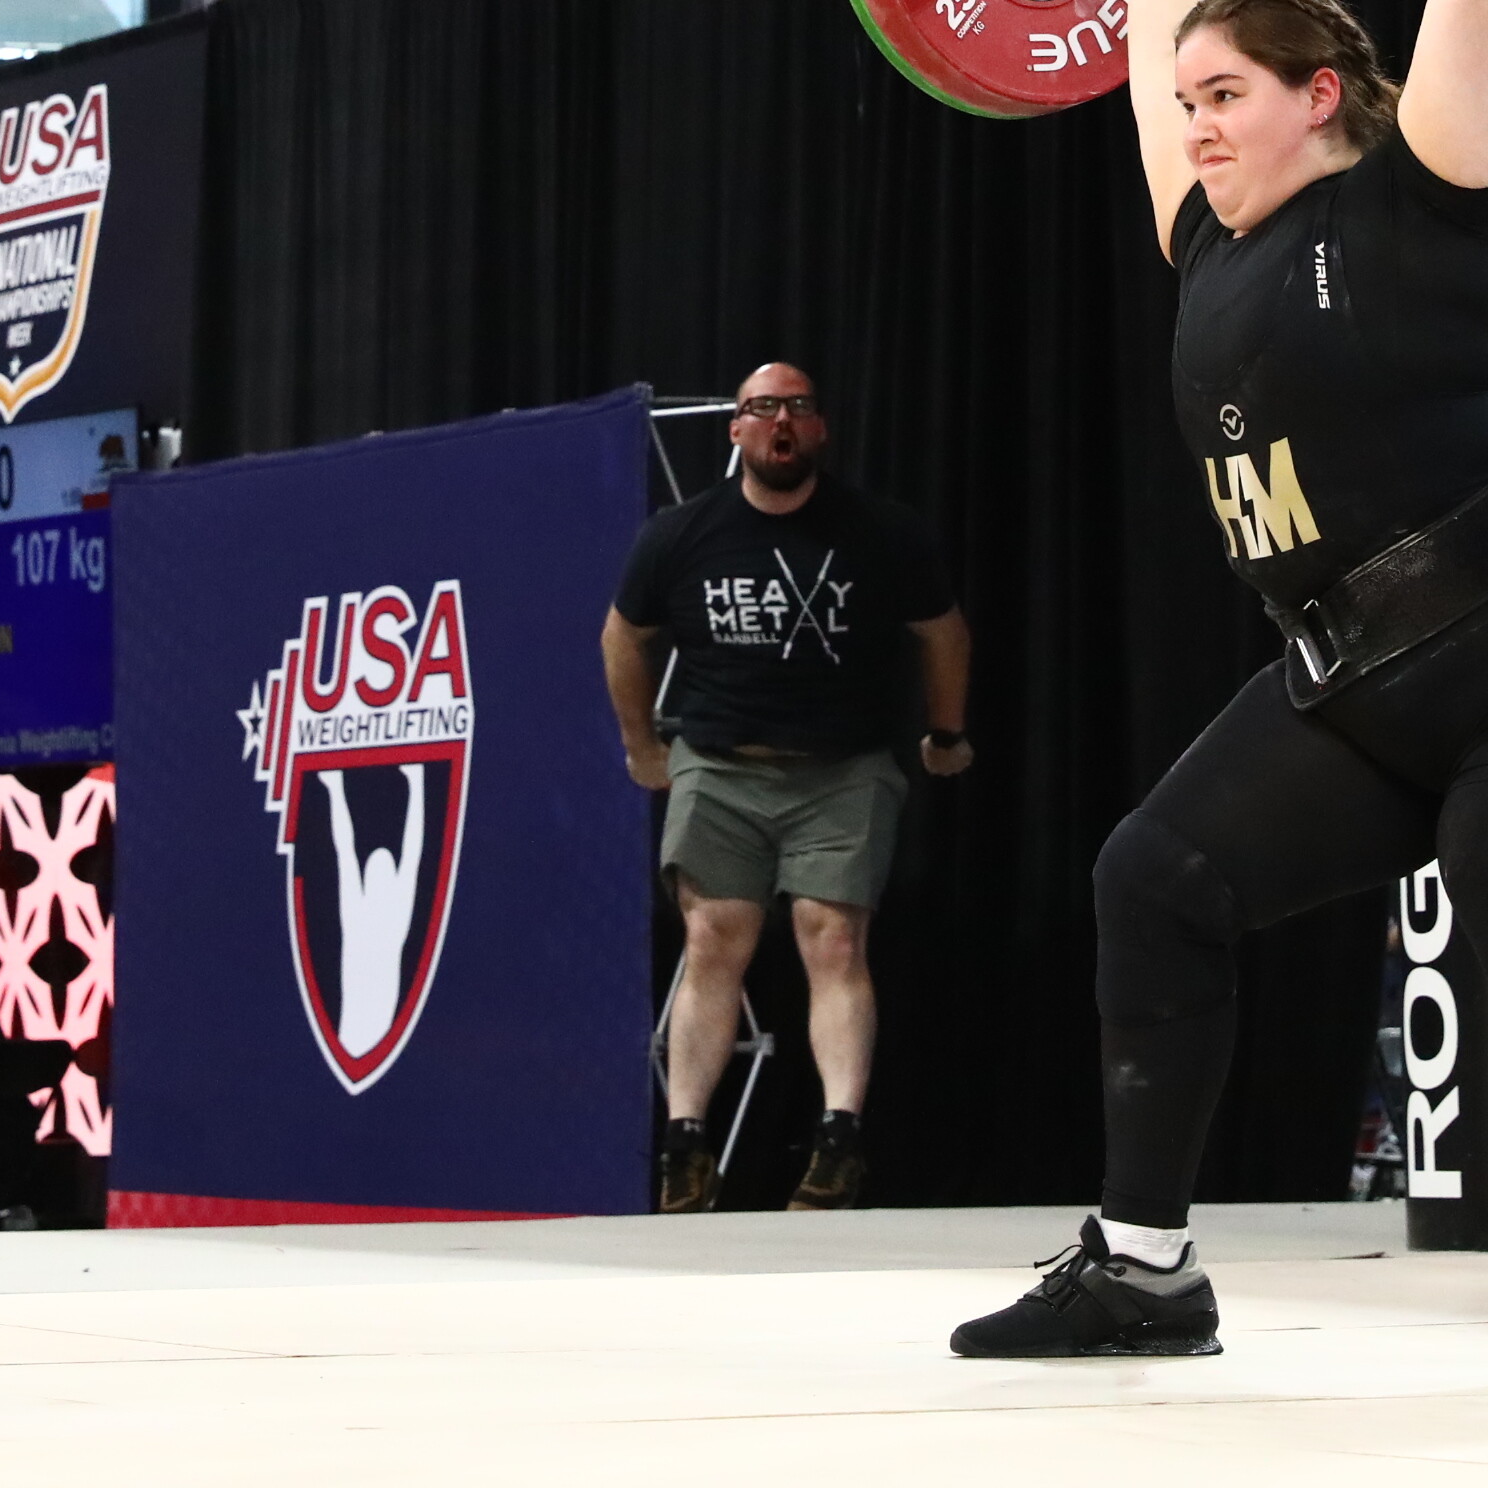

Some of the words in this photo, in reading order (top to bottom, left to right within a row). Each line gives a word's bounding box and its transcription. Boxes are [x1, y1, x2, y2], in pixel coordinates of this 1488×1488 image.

[956, 0, 988, 39] COMPETITION
[972, 20, 986, 36] KG
[1315, 241, 1331, 310] VIRUS
[11, 528, 61, 588] 107
[68, 526, 105, 593] kg
[301, 589, 467, 714] USA
[298, 704, 469, 747] WEIGHTLIFTING
